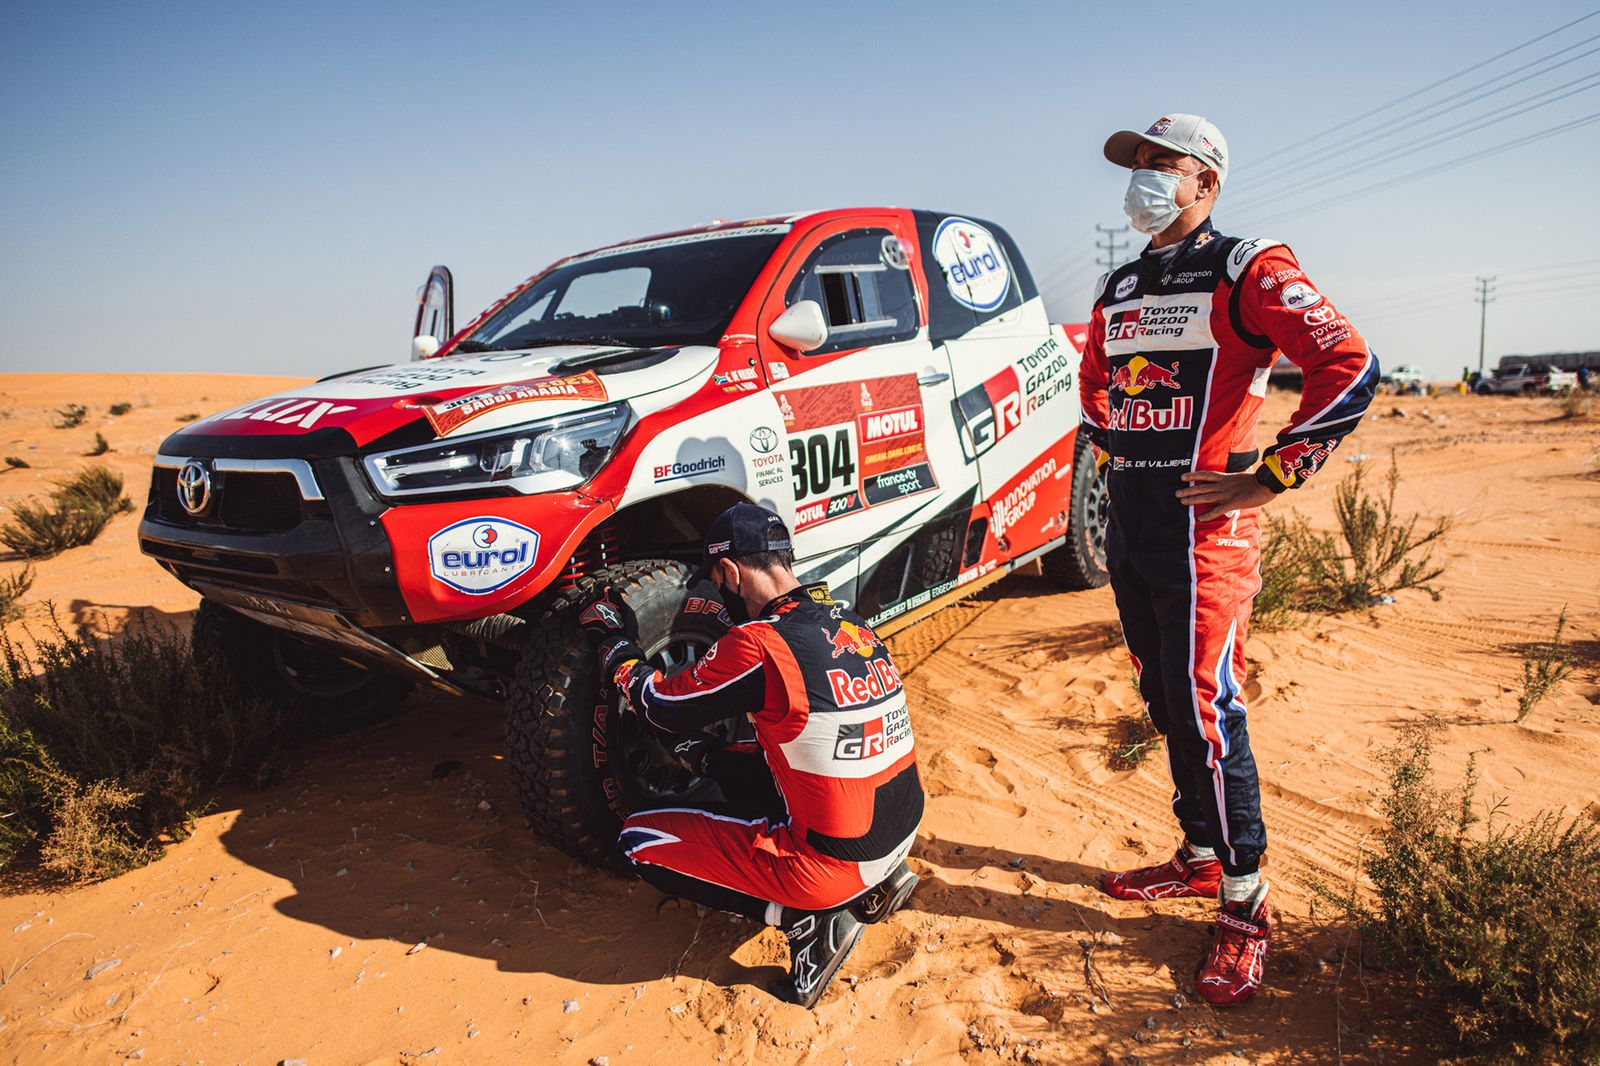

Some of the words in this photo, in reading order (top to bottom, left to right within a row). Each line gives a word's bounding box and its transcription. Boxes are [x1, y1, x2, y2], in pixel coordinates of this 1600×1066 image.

[949, 243, 1000, 284] eurol
[1139, 316, 1189, 326] GAZOO
[1142, 306, 1198, 316] TOYOTA
[1107, 321, 1138, 341] GR
[1138, 326, 1184, 338] Racing
[1310, 319, 1348, 339] TOYOTA
[1016, 338, 1059, 373] TOYOTA
[1025, 355, 1068, 396] GAZOO
[461, 392, 515, 415] SAUDI
[515, 385, 579, 400] ARABIA
[1026, 373, 1072, 416] Racing
[866, 409, 918, 441] MOTUL
[960, 390, 1021, 460] GR
[1129, 396, 1193, 431] Bull
[653, 456, 726, 479] BFGoodrich
[752, 453, 784, 468] TOYOTA
[755, 466, 784, 478] FINANCAL
[787, 428, 855, 502] 304
[1125, 460, 1133, 468] G.
[1134, 460, 1147, 468] DE
[1148, 458, 1192, 468] VILLIERS
[758, 474, 784, 488] SERVICES
[898, 478, 923, 497] sport
[828, 493, 857, 514] 300V
[1005, 490, 1036, 528] GROUP
[441, 541, 529, 569] eurol
[443, 564, 525, 577] LUBRICANTS
[825, 659, 886, 708] Red
[835, 731, 885, 761] GR
